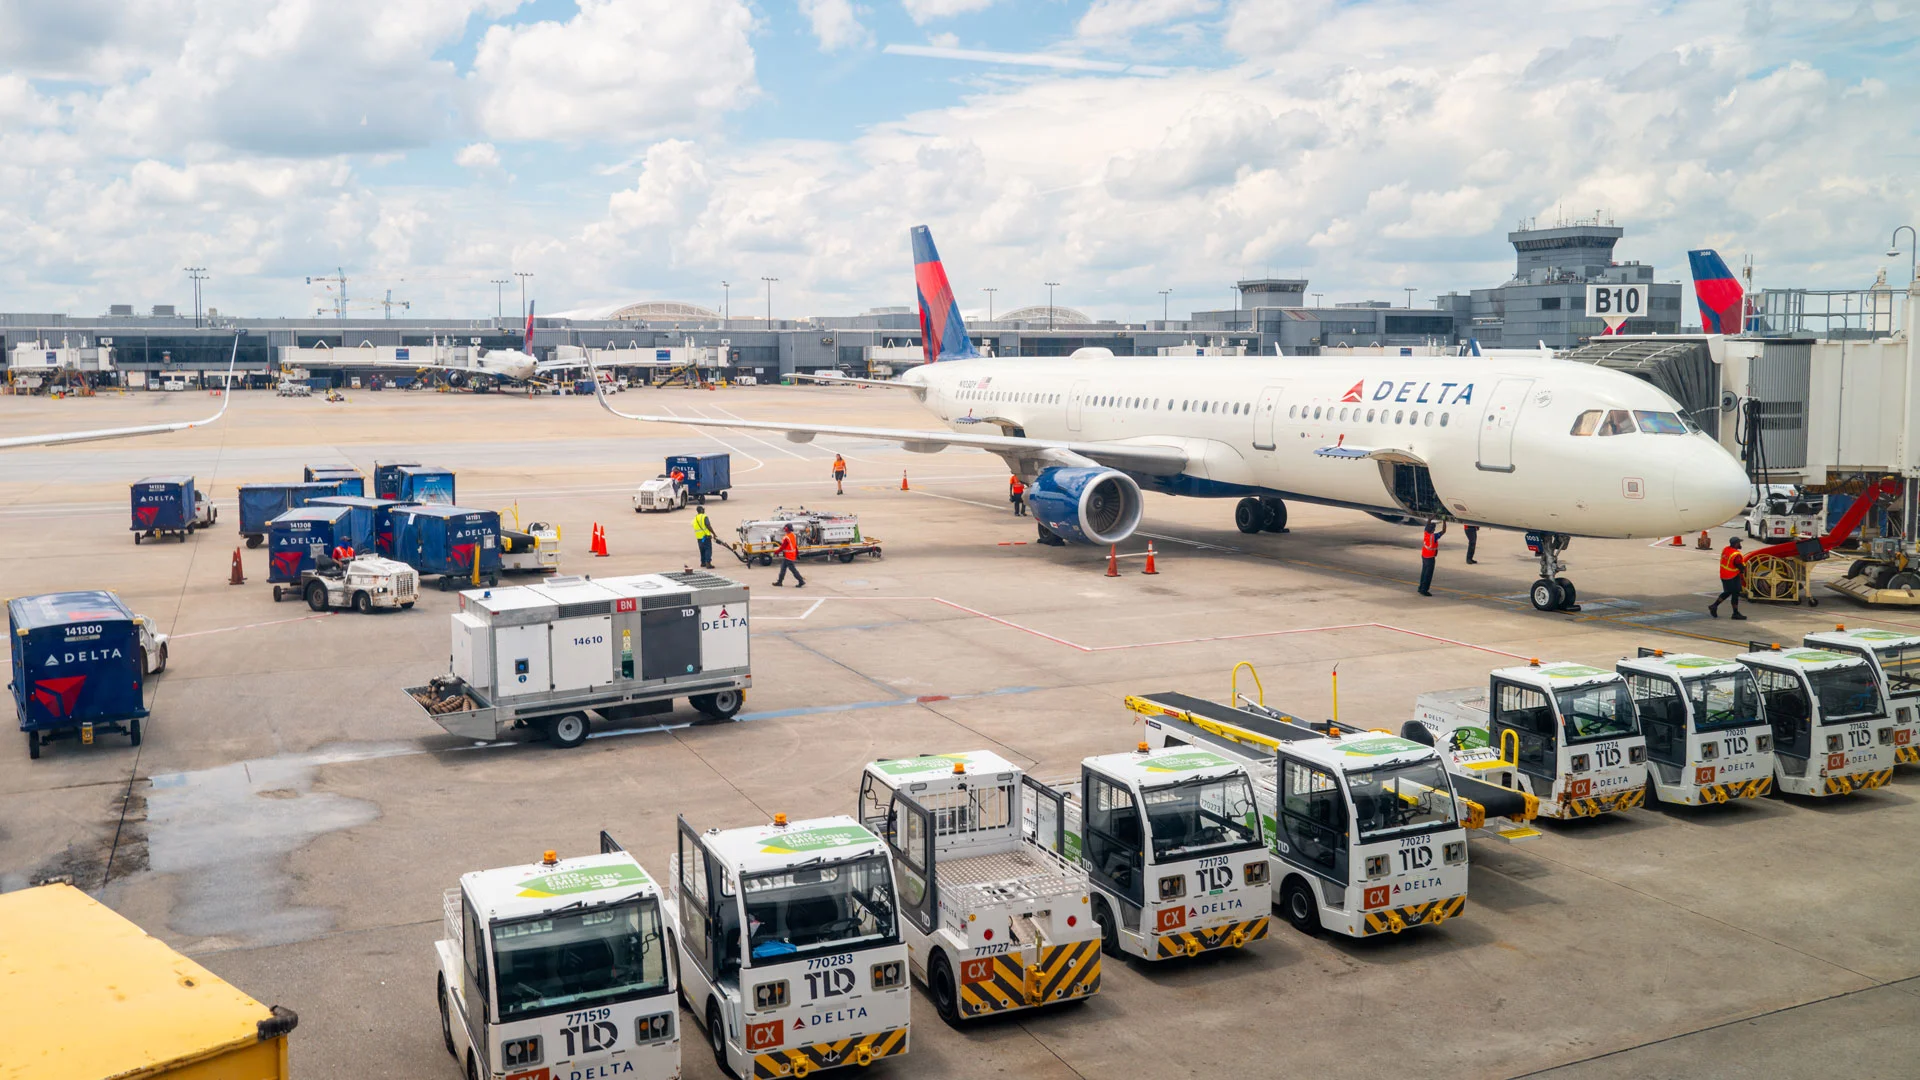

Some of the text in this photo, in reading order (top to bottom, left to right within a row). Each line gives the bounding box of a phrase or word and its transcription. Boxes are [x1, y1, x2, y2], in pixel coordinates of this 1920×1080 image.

[1595, 287, 1640, 313] B10
[1372, 380, 1475, 405] DELTA
[466, 528, 492, 537] DELTA
[290, 536, 324, 545] DELTA
[620, 601, 633, 611] BN
[681, 608, 695, 617] TLD
[65, 624, 103, 636] 141300
[702, 618, 747, 631] DELTA
[573, 635, 603, 646] 14610
[64, 648, 122, 663] DELTA
[1428, 713, 1445, 723] DELTA
[1850, 722, 1869, 730] 771432
[1848, 730, 1871, 747] TLD
[1898, 732, 1907, 743] CX
[1596, 741, 1619, 751] 771274
[1724, 737, 1749, 755] TLD
[1463, 752, 1496, 762] DELTA
[1596, 748, 1621, 768] TLD
[1831, 756, 1841, 767] CX
[1852, 754, 1877, 764] DELTA
[1728, 762, 1755, 772] DELTA
[1601, 776, 1628, 787] DELTA
[1701, 770, 1711, 781] CX
[1575, 782, 1587, 794] CX
[1277, 840, 1290, 854] TLD
[1400, 835, 1431, 847] 770273
[1082, 858, 1093, 872] TLD
[1199, 855, 1229, 868] 771730
[1399, 846, 1432, 871] TLD
[1196, 866, 1233, 892] TLD
[1405, 877, 1442, 891] DELTA
[1370, 889, 1385, 905] CX
[942, 902, 957, 920] DELTA
[1202, 899, 1243, 915] DELTA
[920, 910, 931, 927] TLD
[1163, 911, 1180, 927] CX
[974, 942, 1009, 957] 771727
[807, 954, 853, 970] 770283
[968, 961, 987, 979] CX
[804, 967, 856, 1000] TLD
[566, 1008, 611, 1026] 771519
[811, 1007, 868, 1026] DELTA
[559, 1021, 618, 1057] TLD
[754, 1025, 776, 1045] CX
[570, 1060, 634, 1080] DELTA
